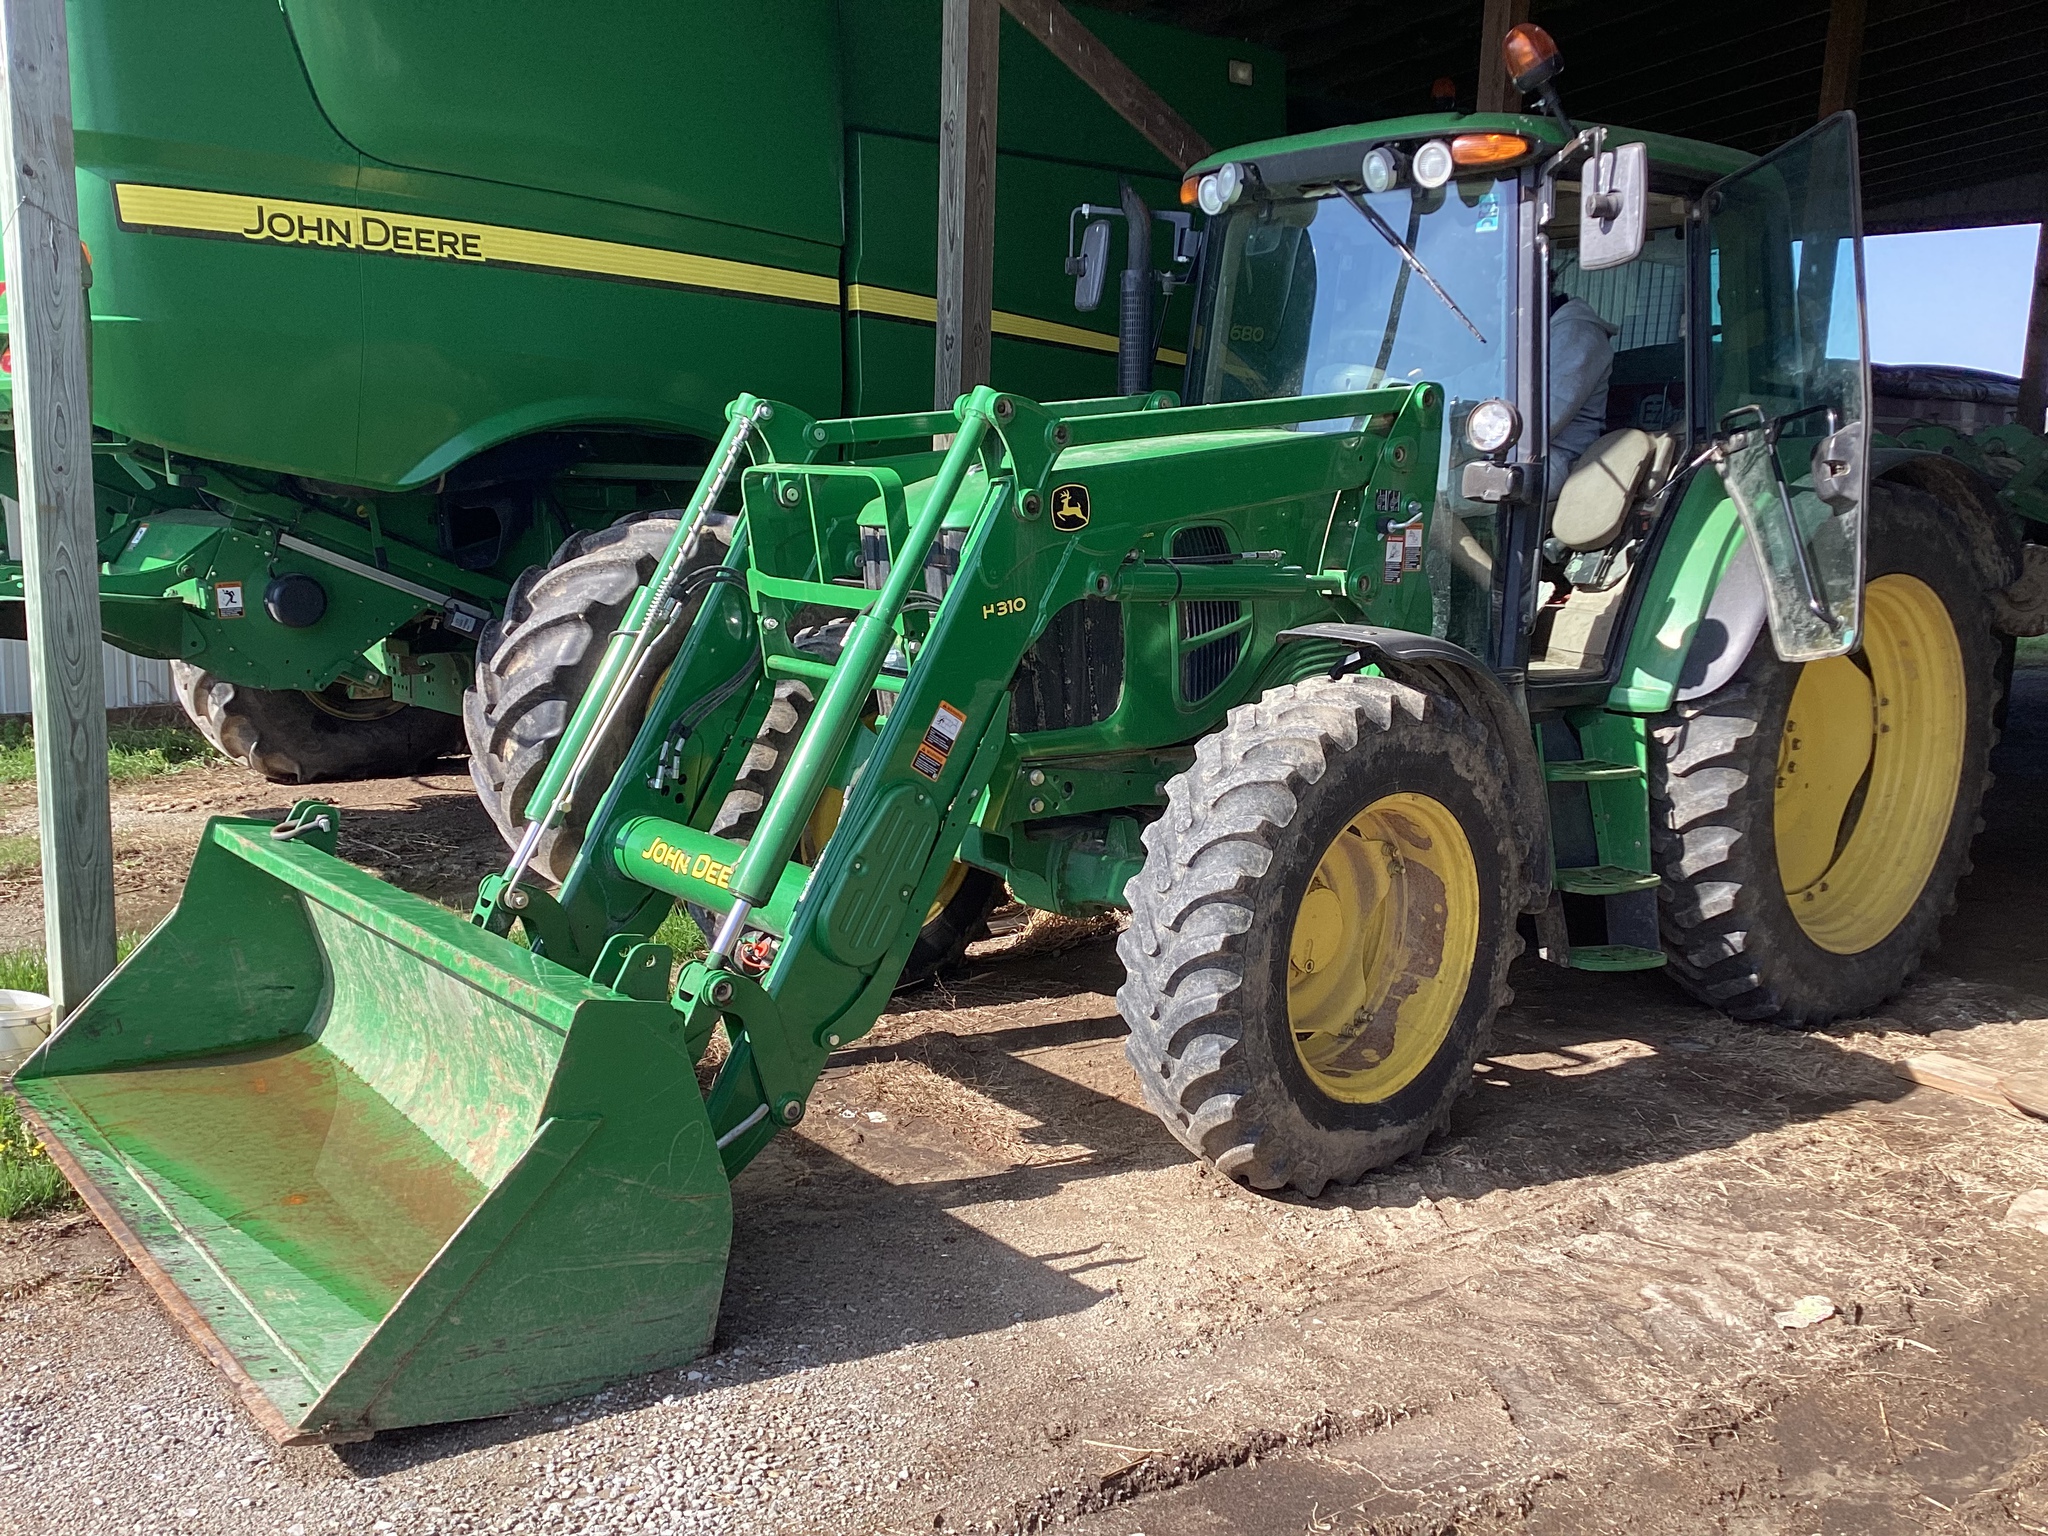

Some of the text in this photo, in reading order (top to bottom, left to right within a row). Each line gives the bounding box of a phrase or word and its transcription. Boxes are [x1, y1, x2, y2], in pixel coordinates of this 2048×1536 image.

[243, 205, 482, 257] JOHN DEERE
[982, 596, 1026, 620] H310
[642, 835, 736, 890] JOHN DEE
